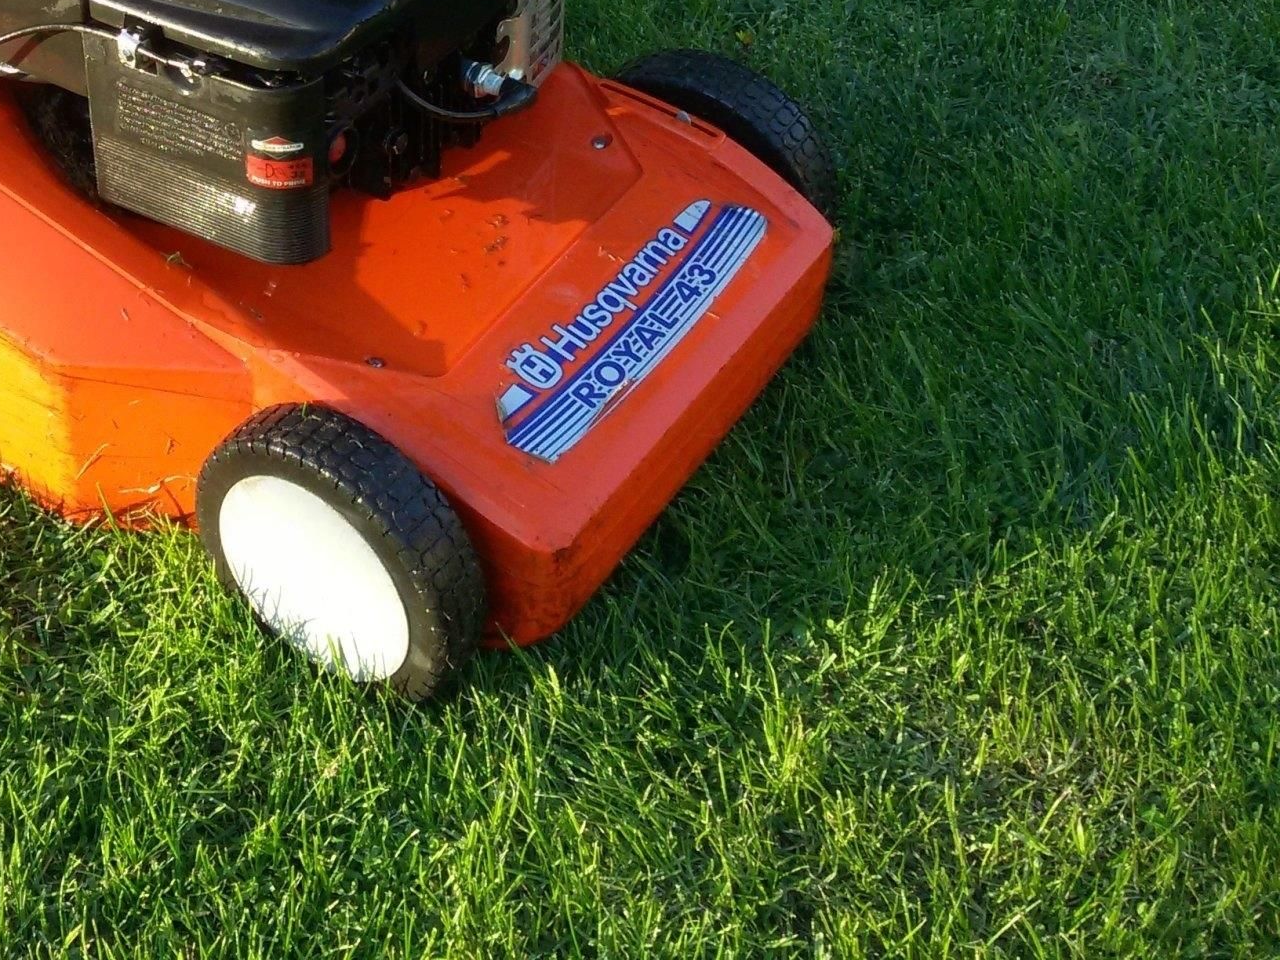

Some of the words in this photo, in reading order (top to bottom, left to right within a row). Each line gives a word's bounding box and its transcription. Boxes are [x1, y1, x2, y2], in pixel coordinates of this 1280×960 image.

[540, 227, 689, 362] Husqvarna
[571, 312, 680, 409] ROYAL
[674, 263, 717, 305] 43
